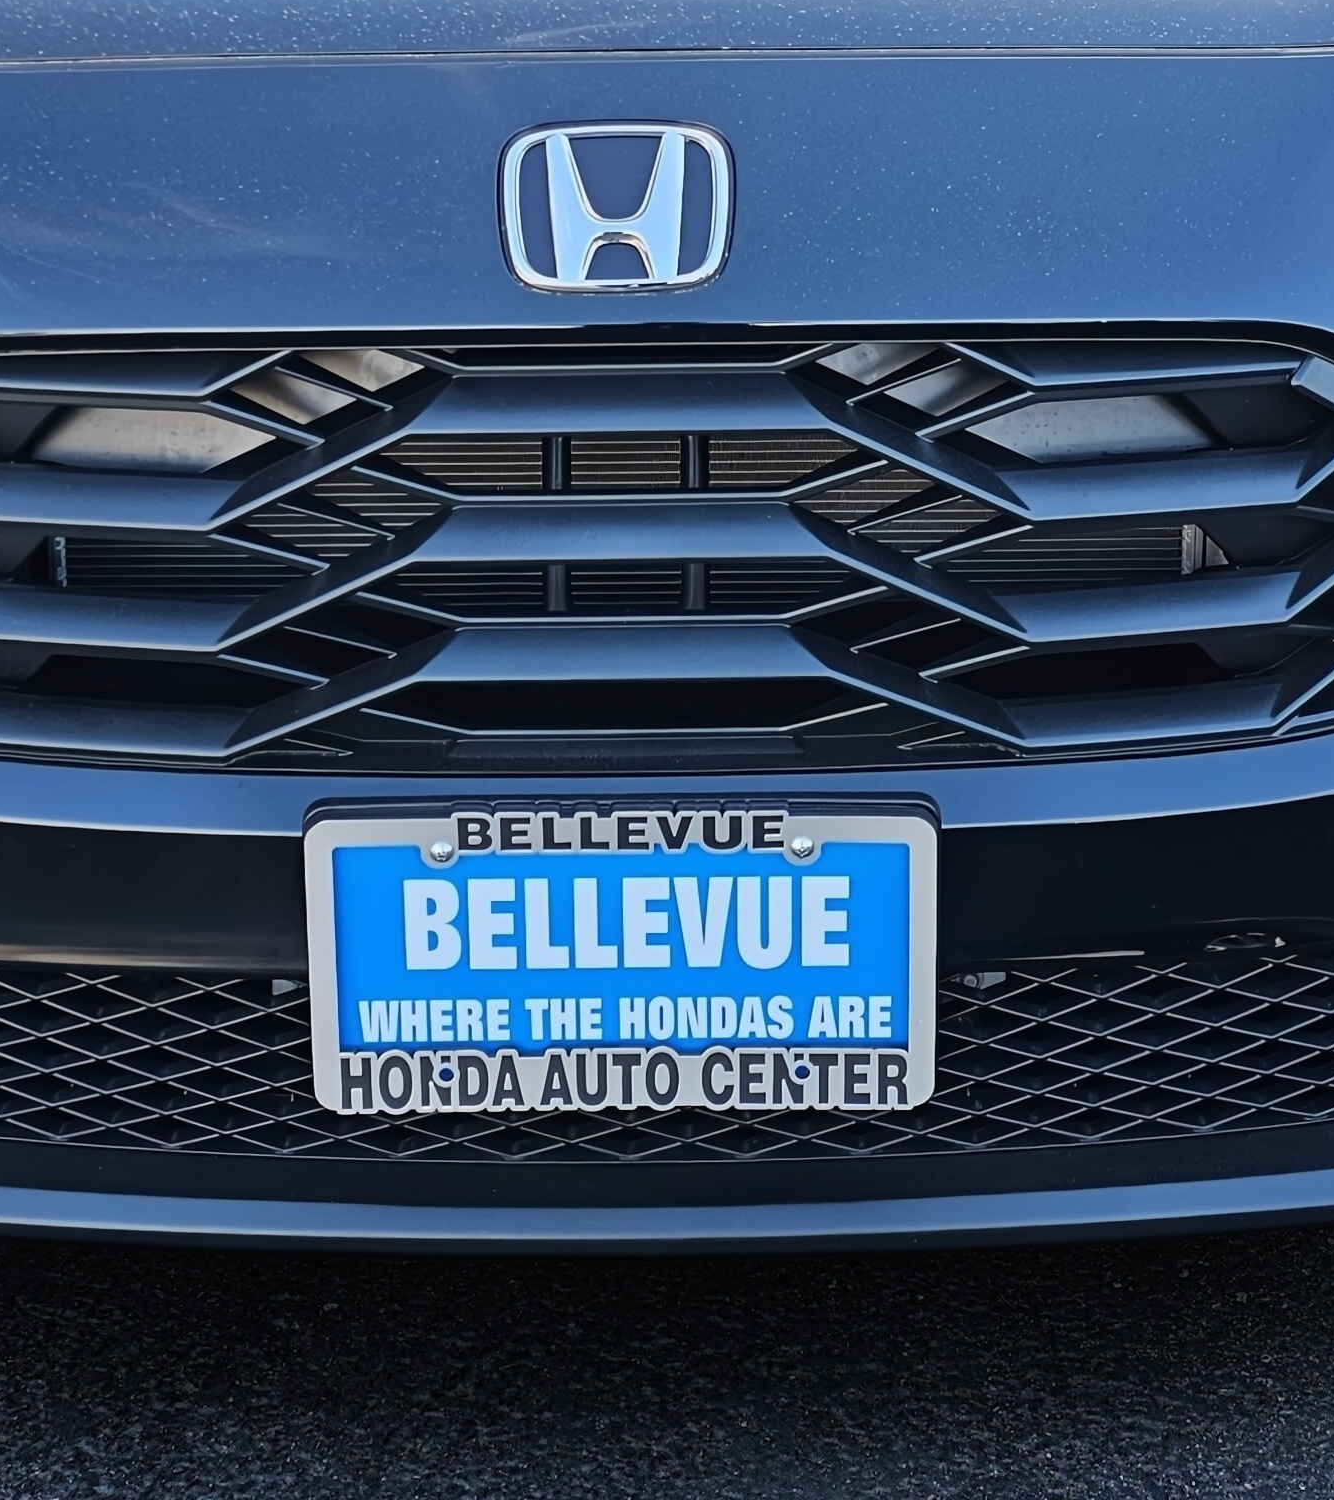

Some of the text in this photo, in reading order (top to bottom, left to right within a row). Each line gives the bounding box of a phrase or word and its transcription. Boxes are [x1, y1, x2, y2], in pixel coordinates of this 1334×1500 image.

[456, 815, 785, 851] BELLEVUE
[403, 875, 850, 971] BELLEVUE
[359, 995, 893, 1043] WHERE THE HONDAS ARE
[340, 1051, 909, 1109] HONDA AUTO CENTER
